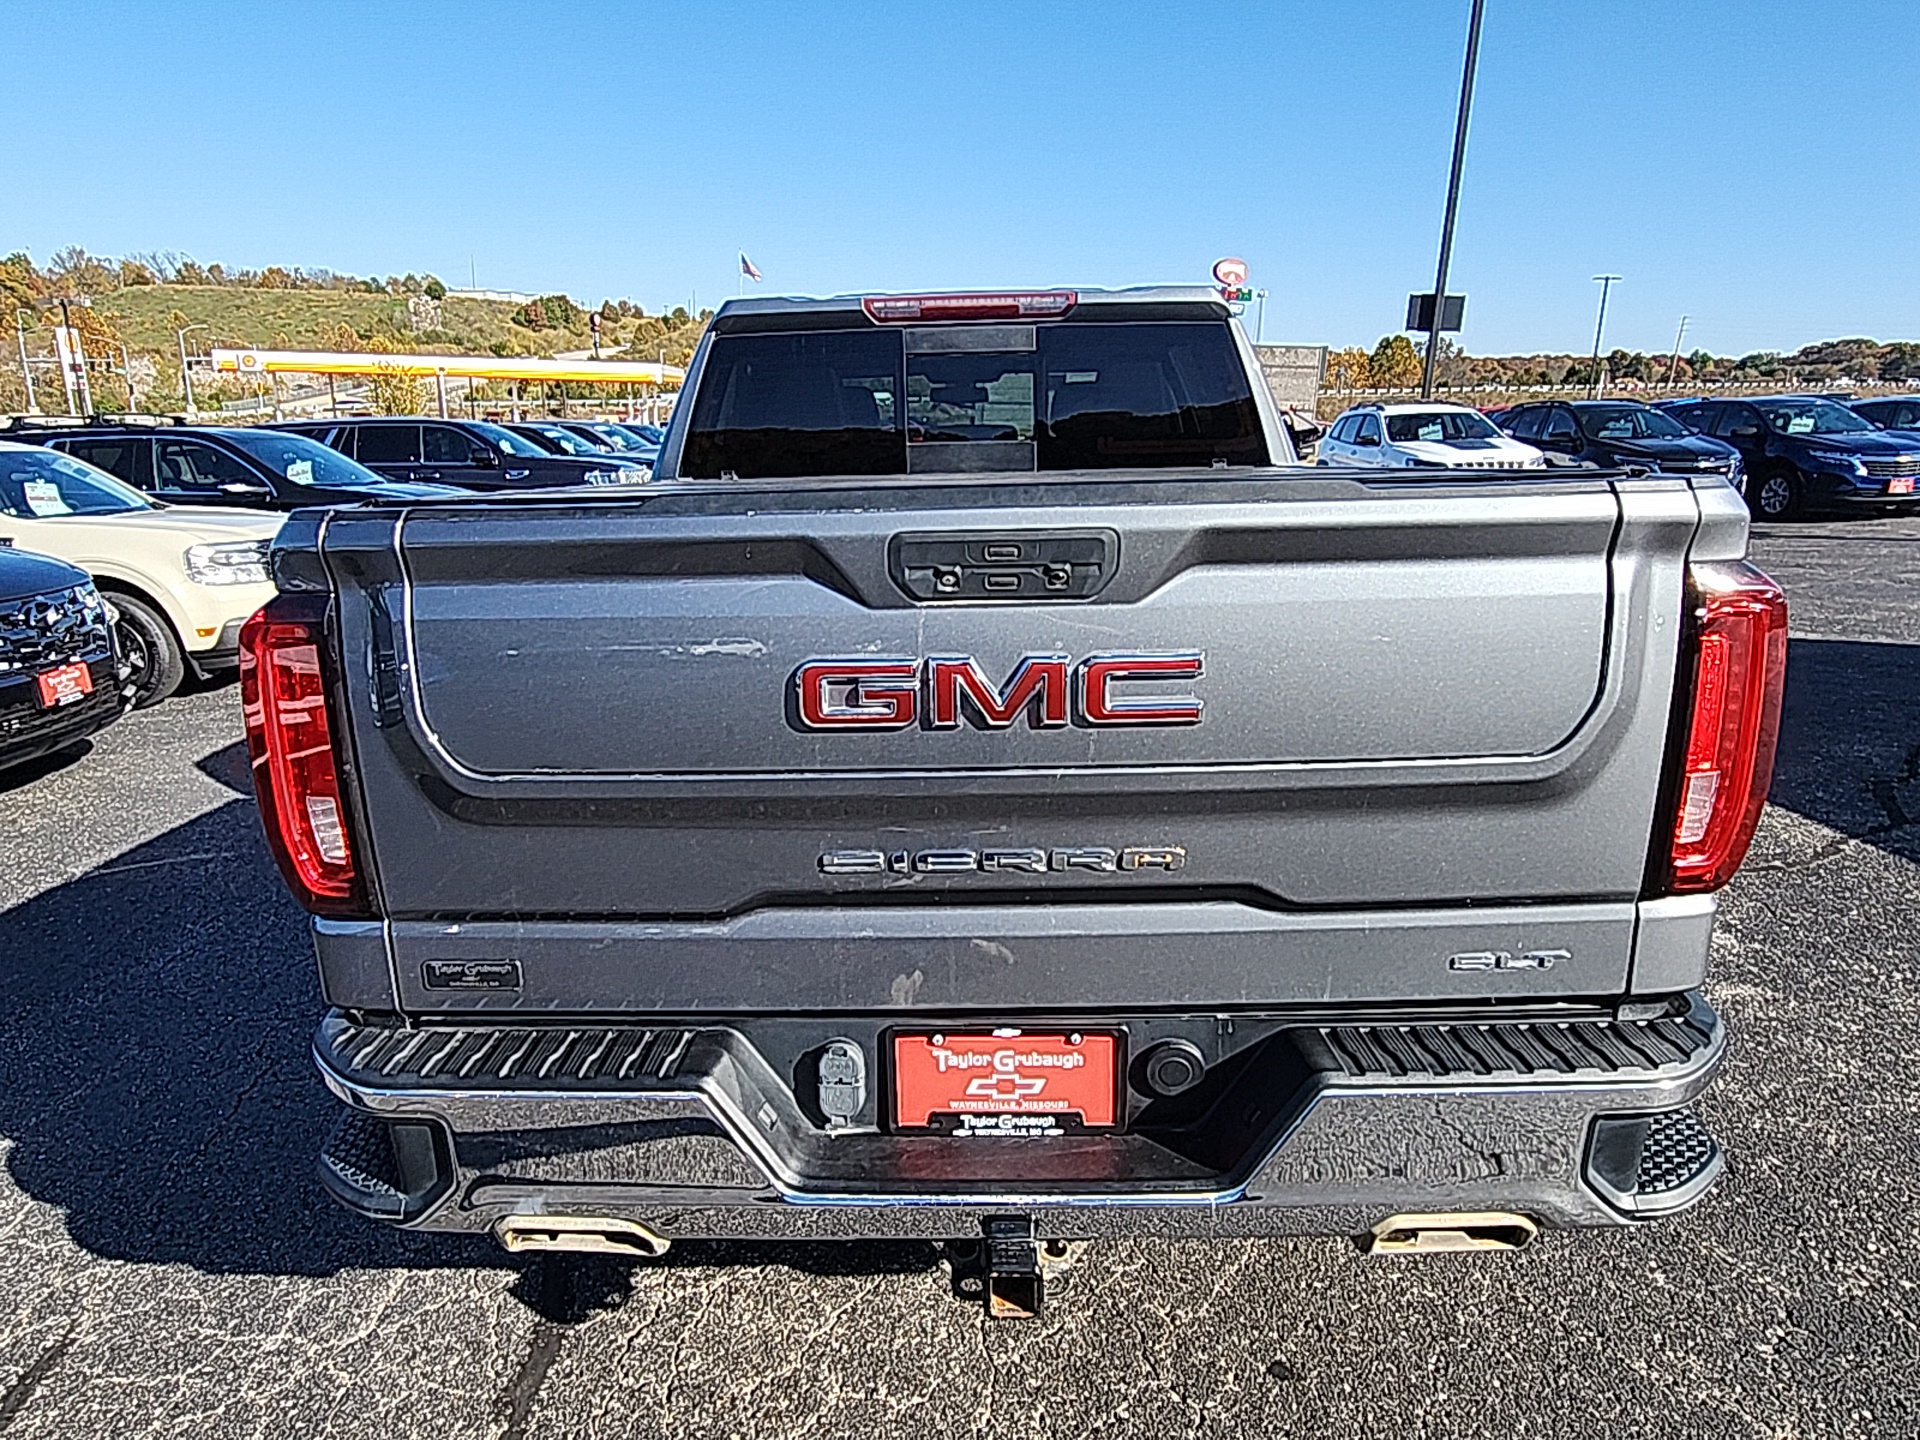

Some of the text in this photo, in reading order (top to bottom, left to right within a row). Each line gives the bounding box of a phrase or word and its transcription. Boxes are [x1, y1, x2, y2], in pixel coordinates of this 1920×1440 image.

[787, 652, 1206, 731] GMC
[818, 847, 1186, 874] SIERRA
[1447, 950, 1571, 973] SLT
[932, 1050, 1084, 1072] Taylor Grubaugh
[1020, 1101, 1068, 1110] MISSOURI
[960, 1114, 1056, 1128] Taylor Grubaugh
